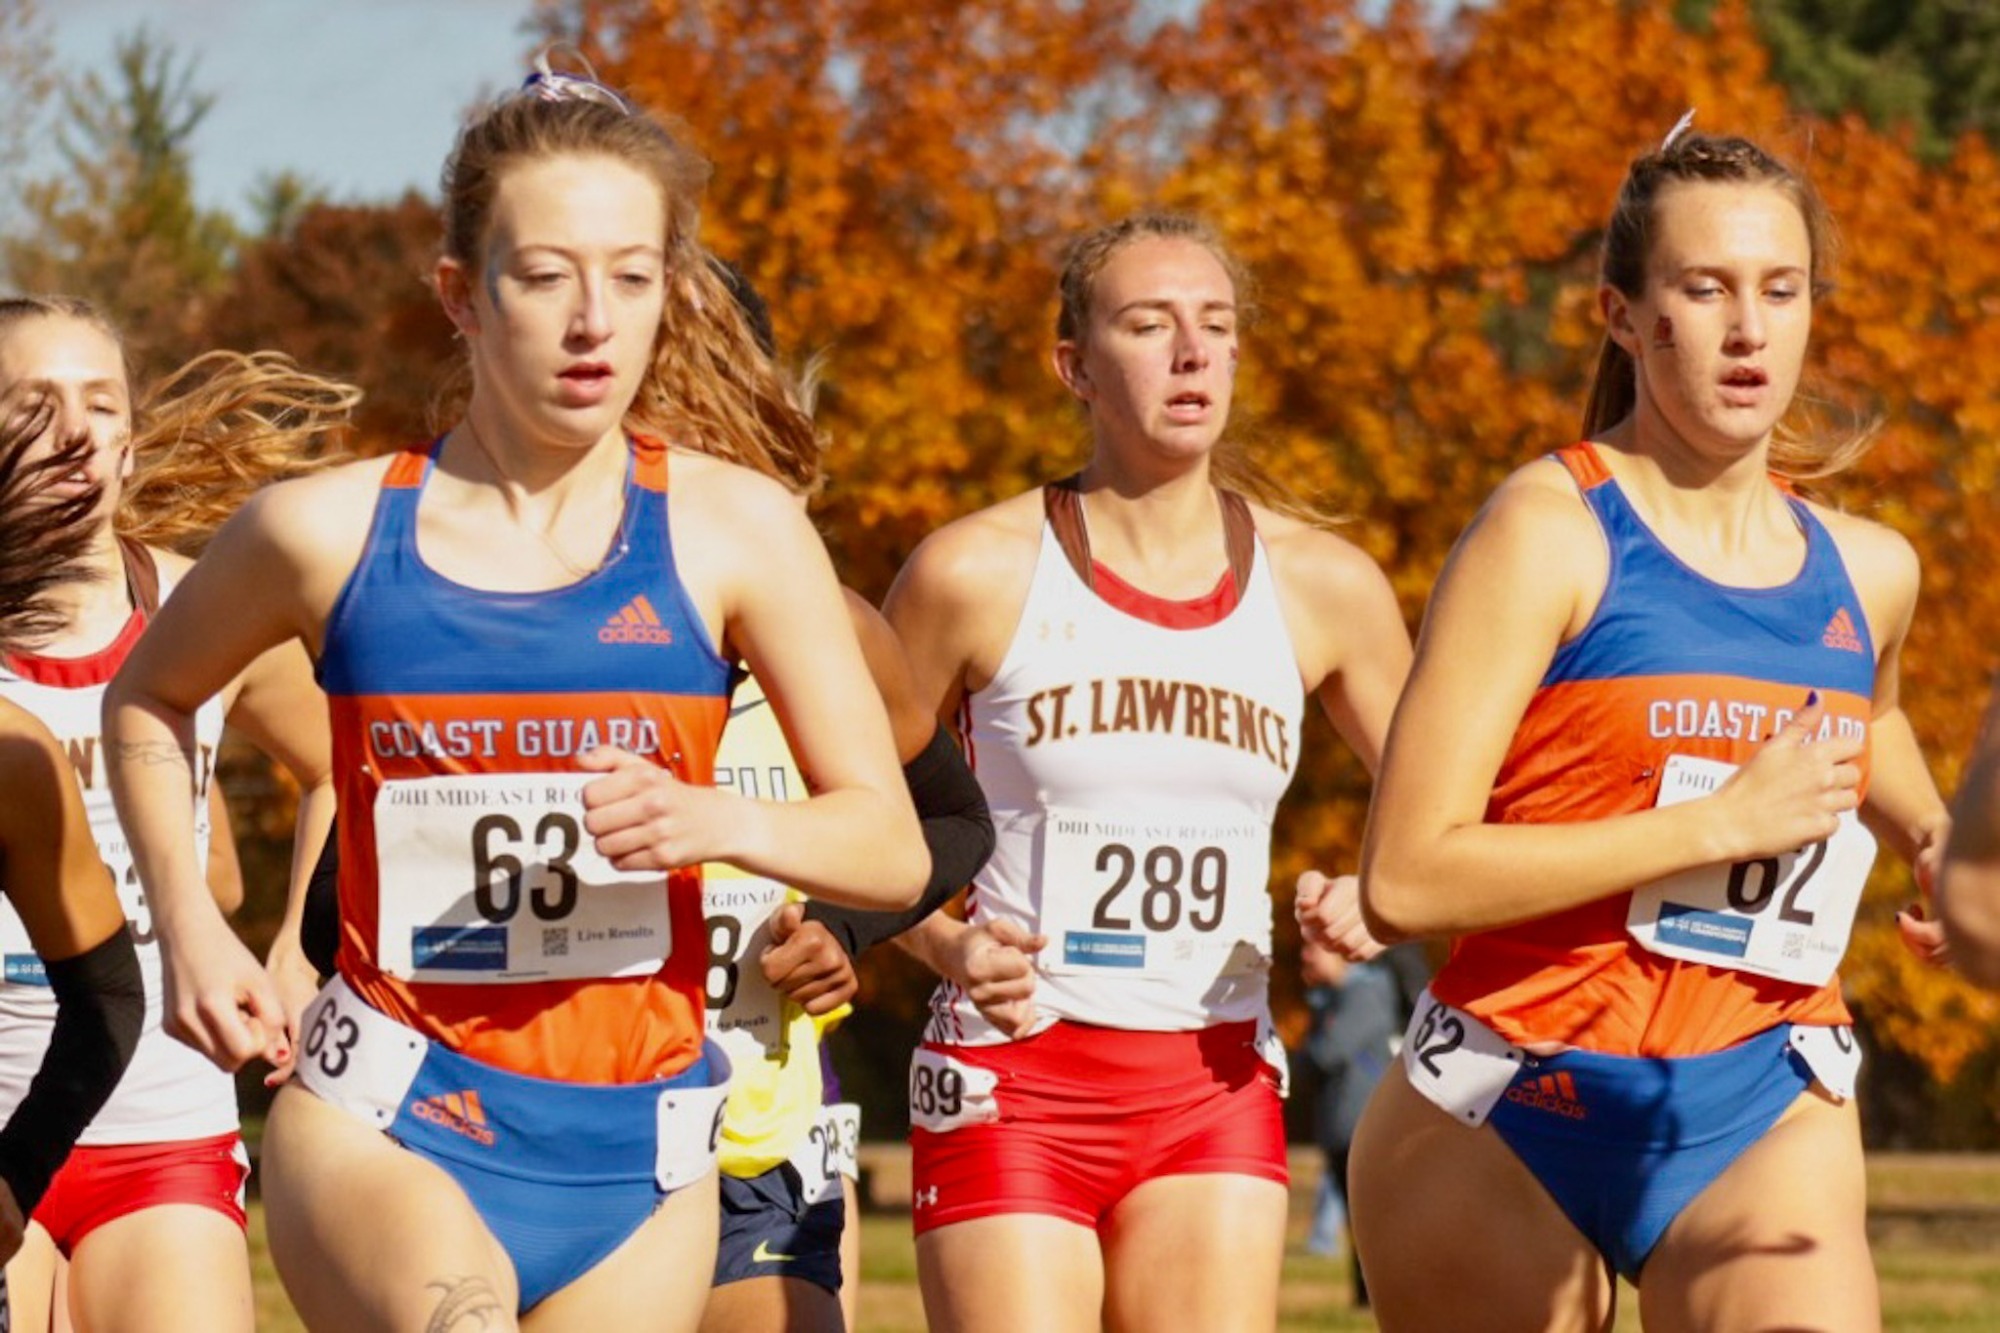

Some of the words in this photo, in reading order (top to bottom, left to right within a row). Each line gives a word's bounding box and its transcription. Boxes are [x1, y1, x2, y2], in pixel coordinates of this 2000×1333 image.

[599, 623, 672, 645] adidas
[370, 720, 504, 759] COAST
[515, 718, 661, 758] GUARD
[1025, 684, 1078, 748] ST.
[1089, 677, 1291, 774] LAWRENCE
[1648, 698, 1767, 743] COAST
[434, 786, 535, 807] MIDEAST
[471, 811, 580, 924] 63
[1091, 842, 1229, 933] 289
[304, 996, 360, 1079] 63
[1413, 1002, 1465, 1079] 62
[410, 1101, 496, 1147] adidas
[1505, 1087, 1587, 1120] adidas
